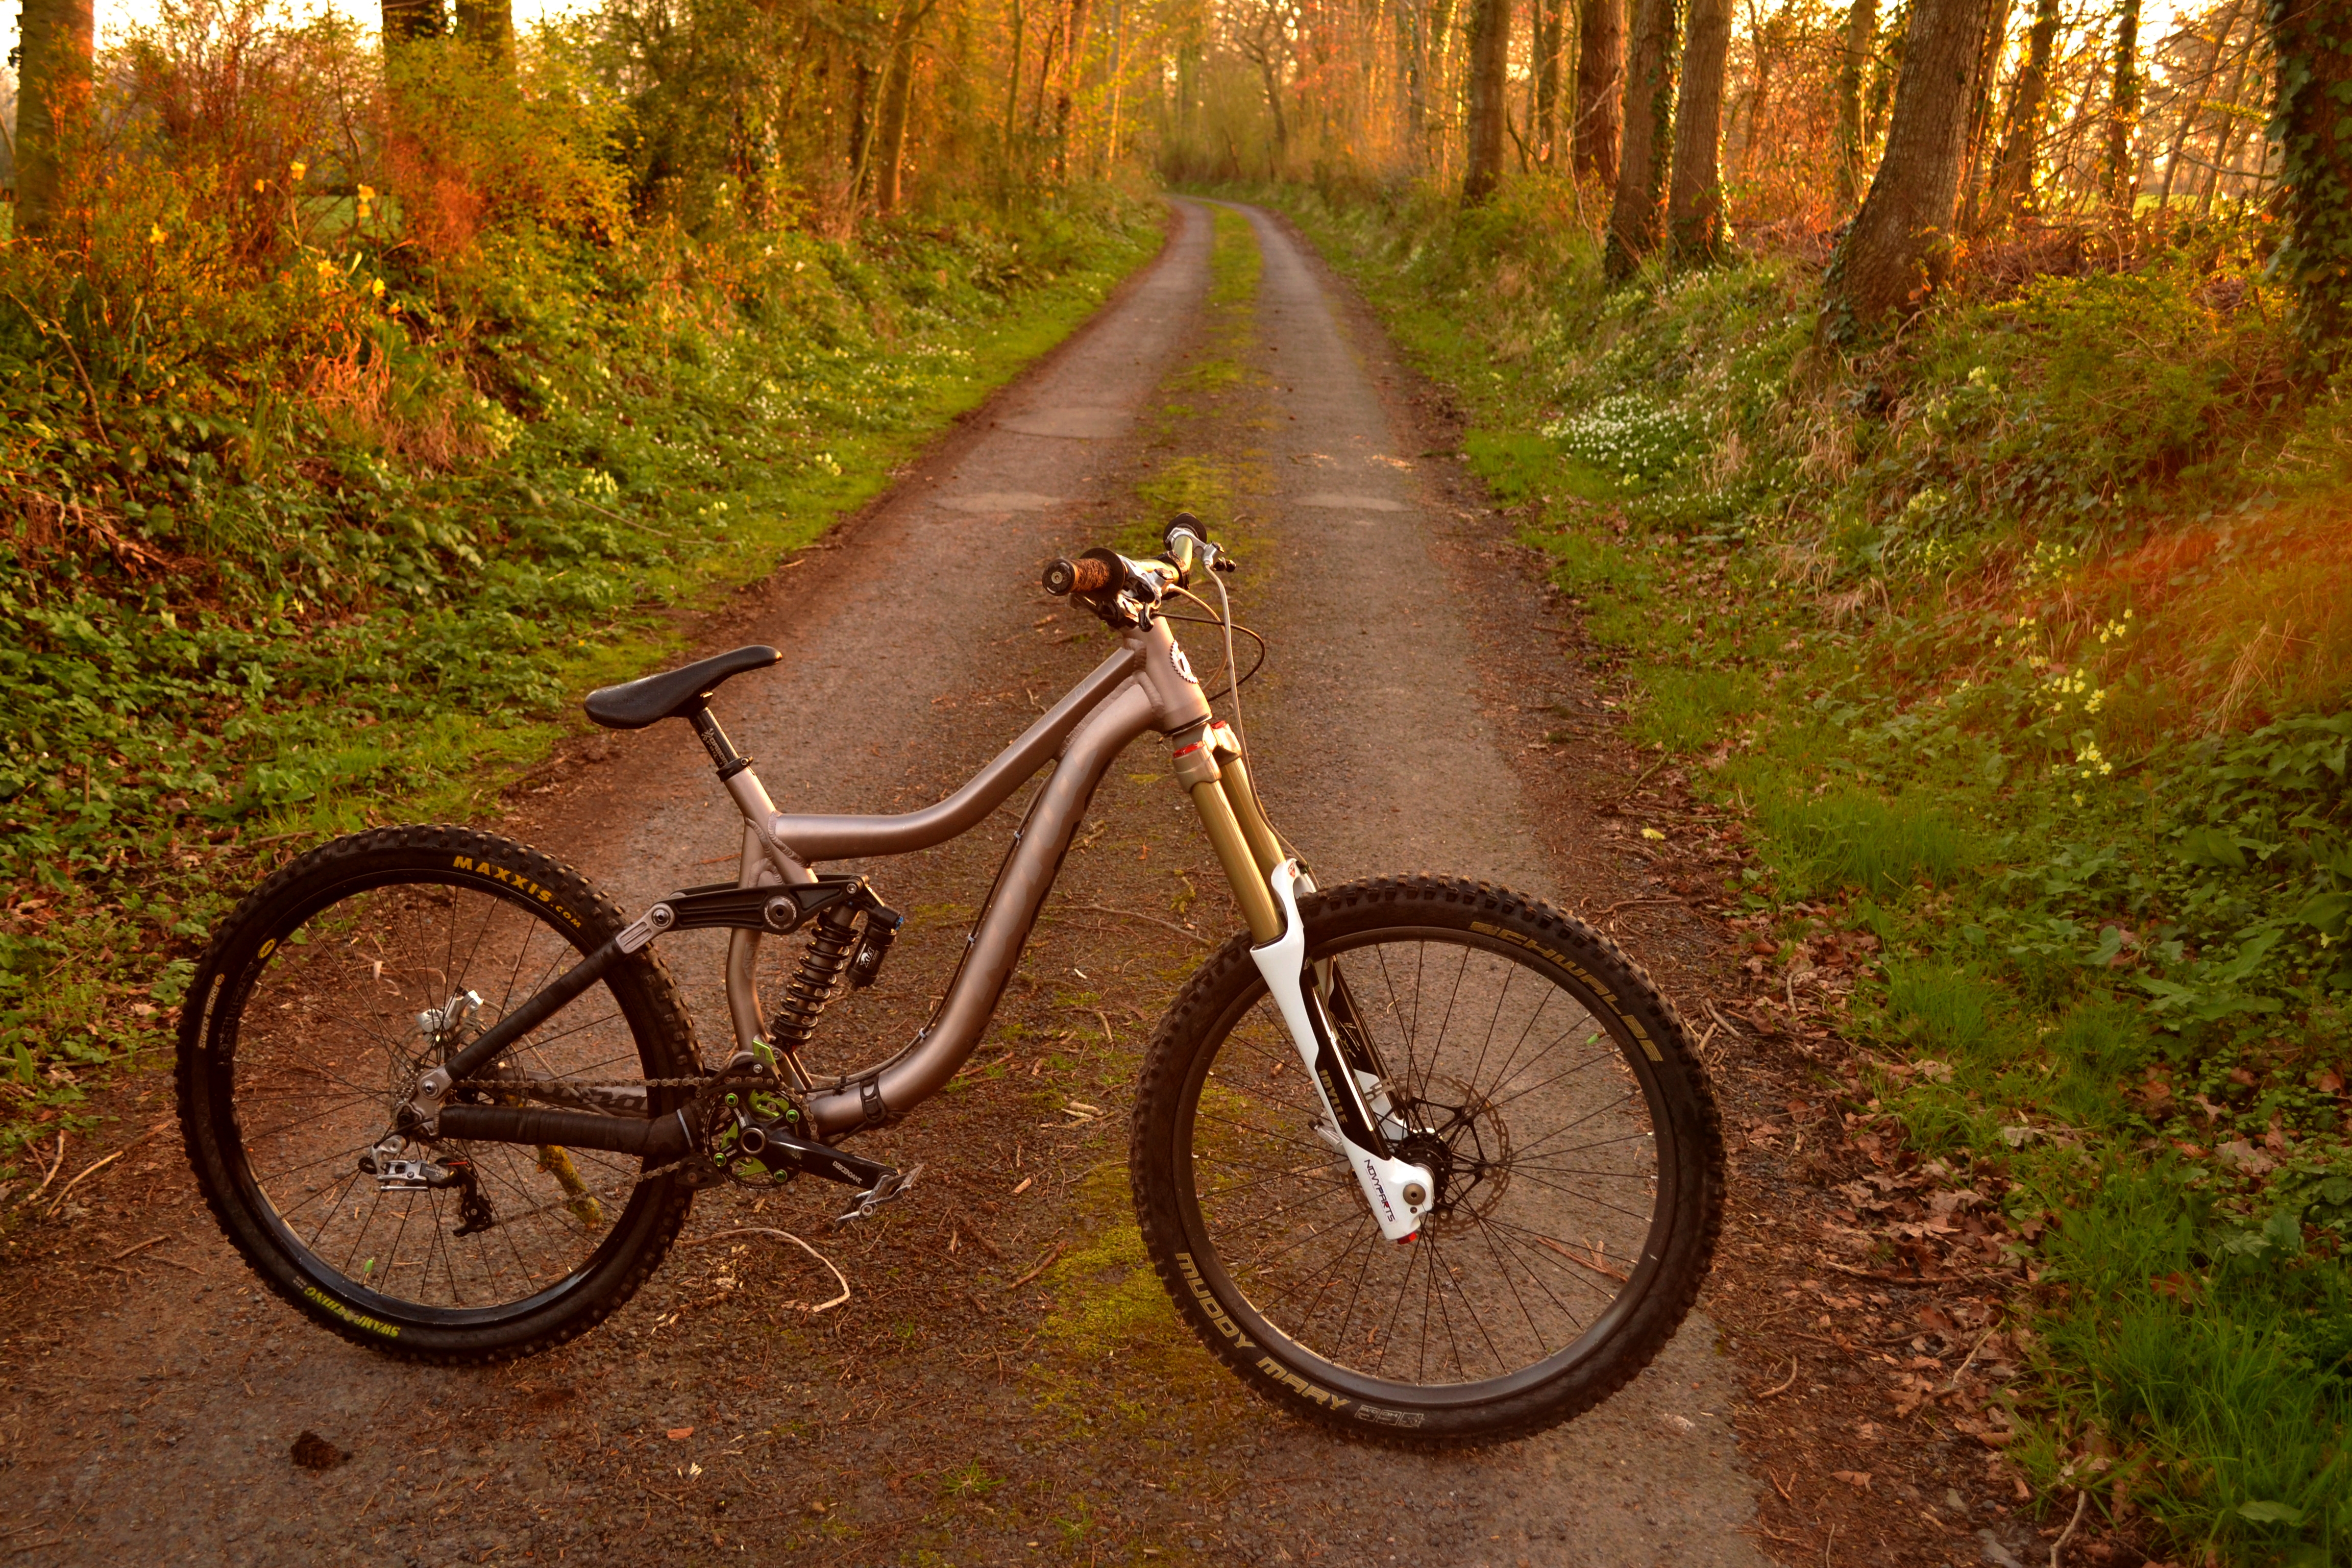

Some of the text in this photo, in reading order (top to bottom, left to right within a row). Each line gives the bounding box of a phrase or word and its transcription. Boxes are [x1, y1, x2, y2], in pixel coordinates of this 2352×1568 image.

[861, 946, 874, 968] FOX
[198, 1019, 210, 1049] SUPER
[205, 985, 220, 1016] TACKY
[1468, 921, 1663, 1062] SCHWALBE
[1318, 1069, 1348, 1125] IDYLLE
[832, 1161, 863, 1184] DESCENDANT
[1364, 1159, 1397, 1222] NOVYPARTS
[304, 1287, 401, 1337] SWAMP THING
[1175, 1253, 1352, 1410] MUDDY MARY
